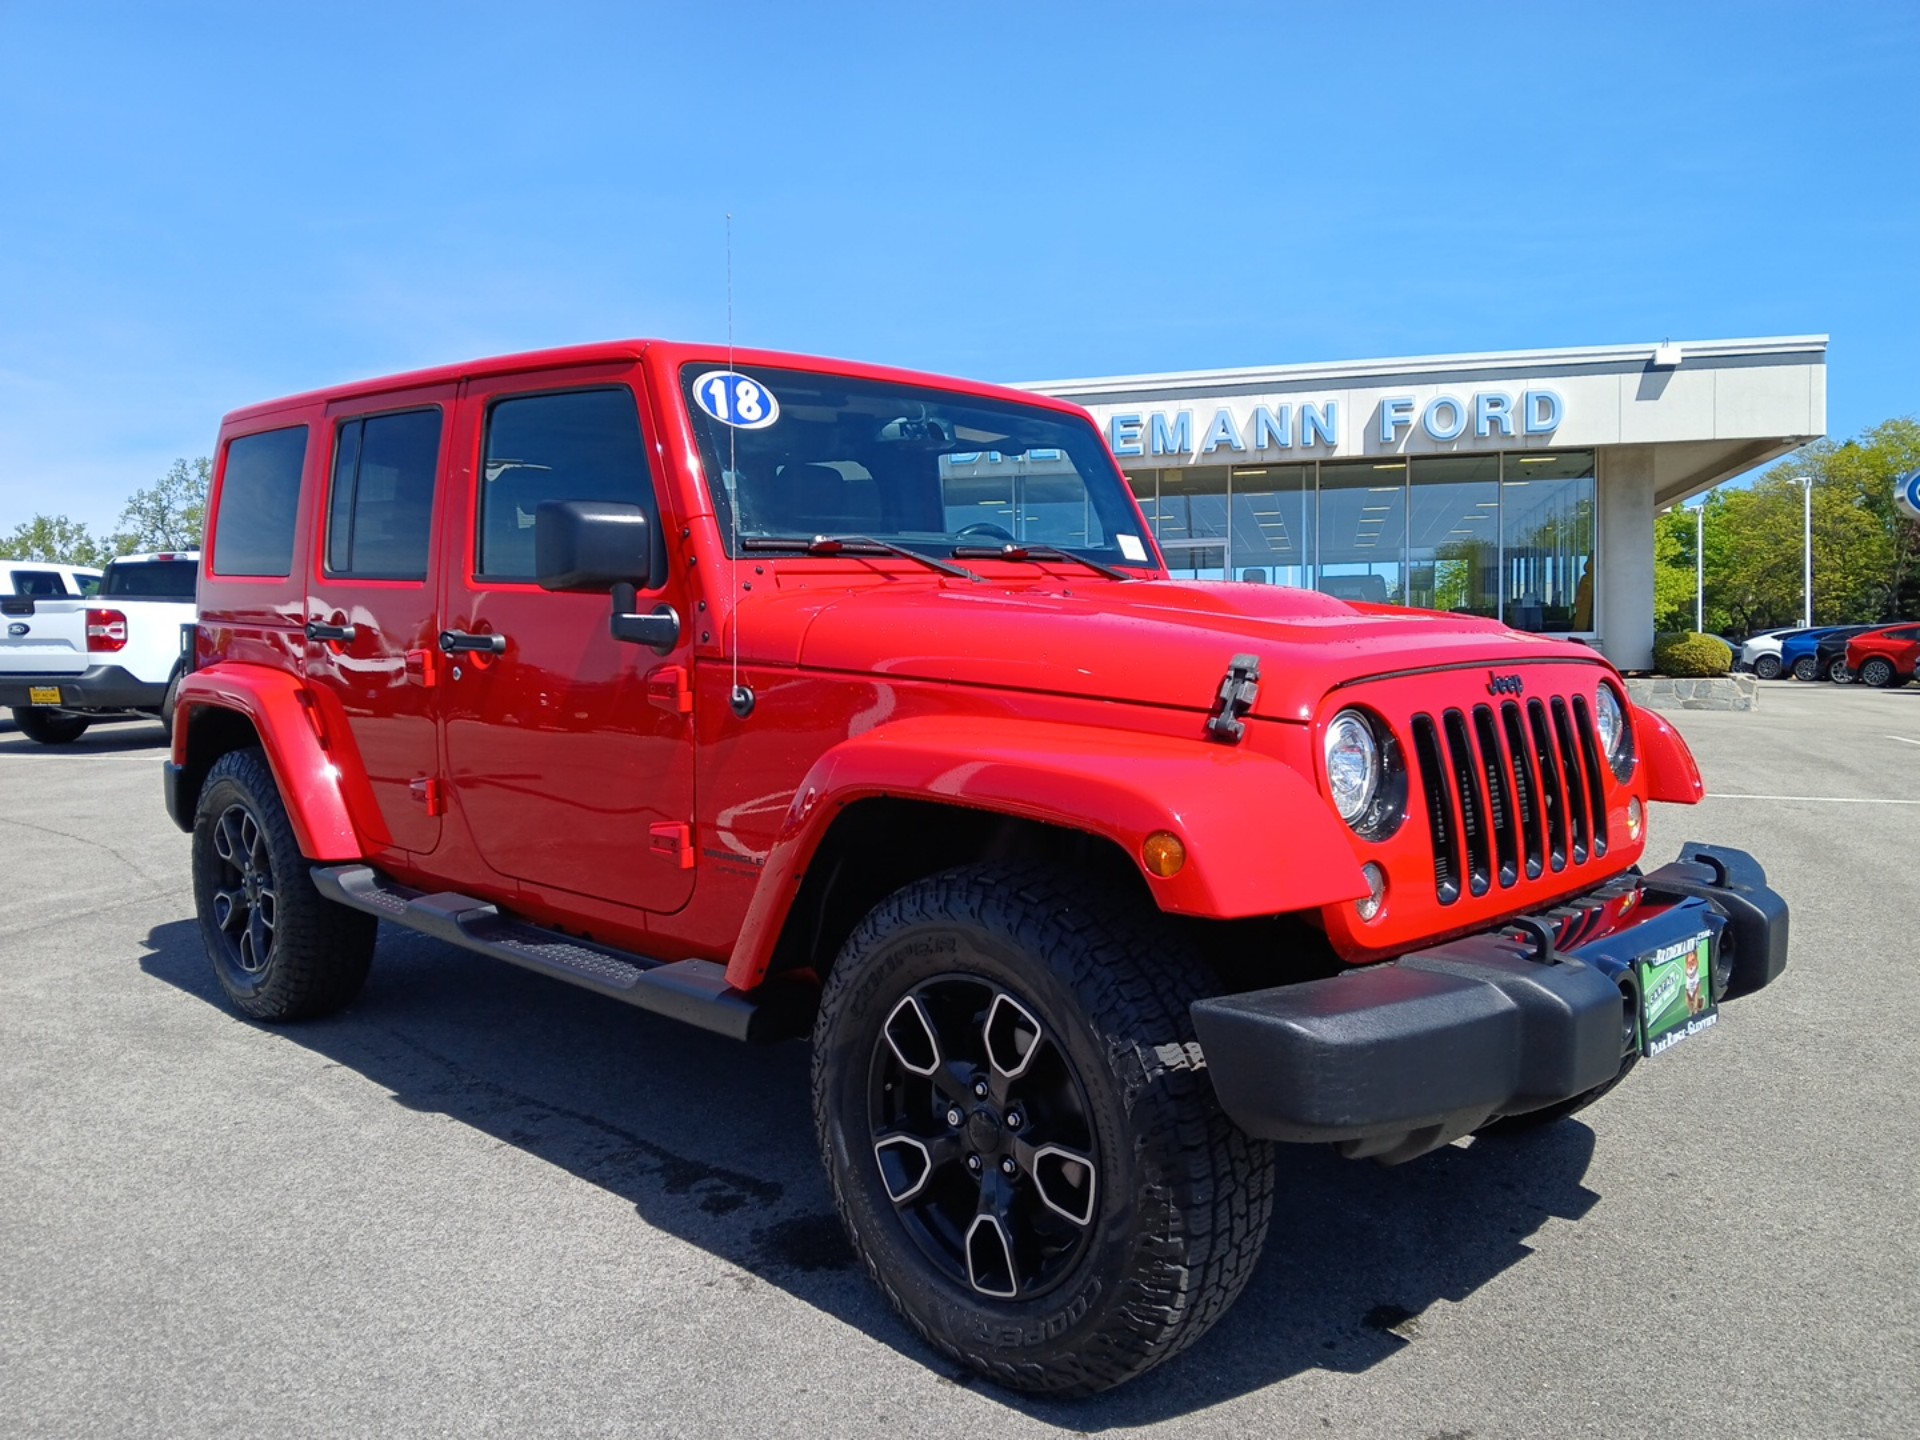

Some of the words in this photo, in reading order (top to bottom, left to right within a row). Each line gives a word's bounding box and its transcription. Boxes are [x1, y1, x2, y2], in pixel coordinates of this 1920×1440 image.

[708, 378, 763, 421] 18
[1380, 388, 1566, 443] FORD
[1485, 670, 1524, 698] Jeep
[974, 1275, 1102, 1348] COOPER
